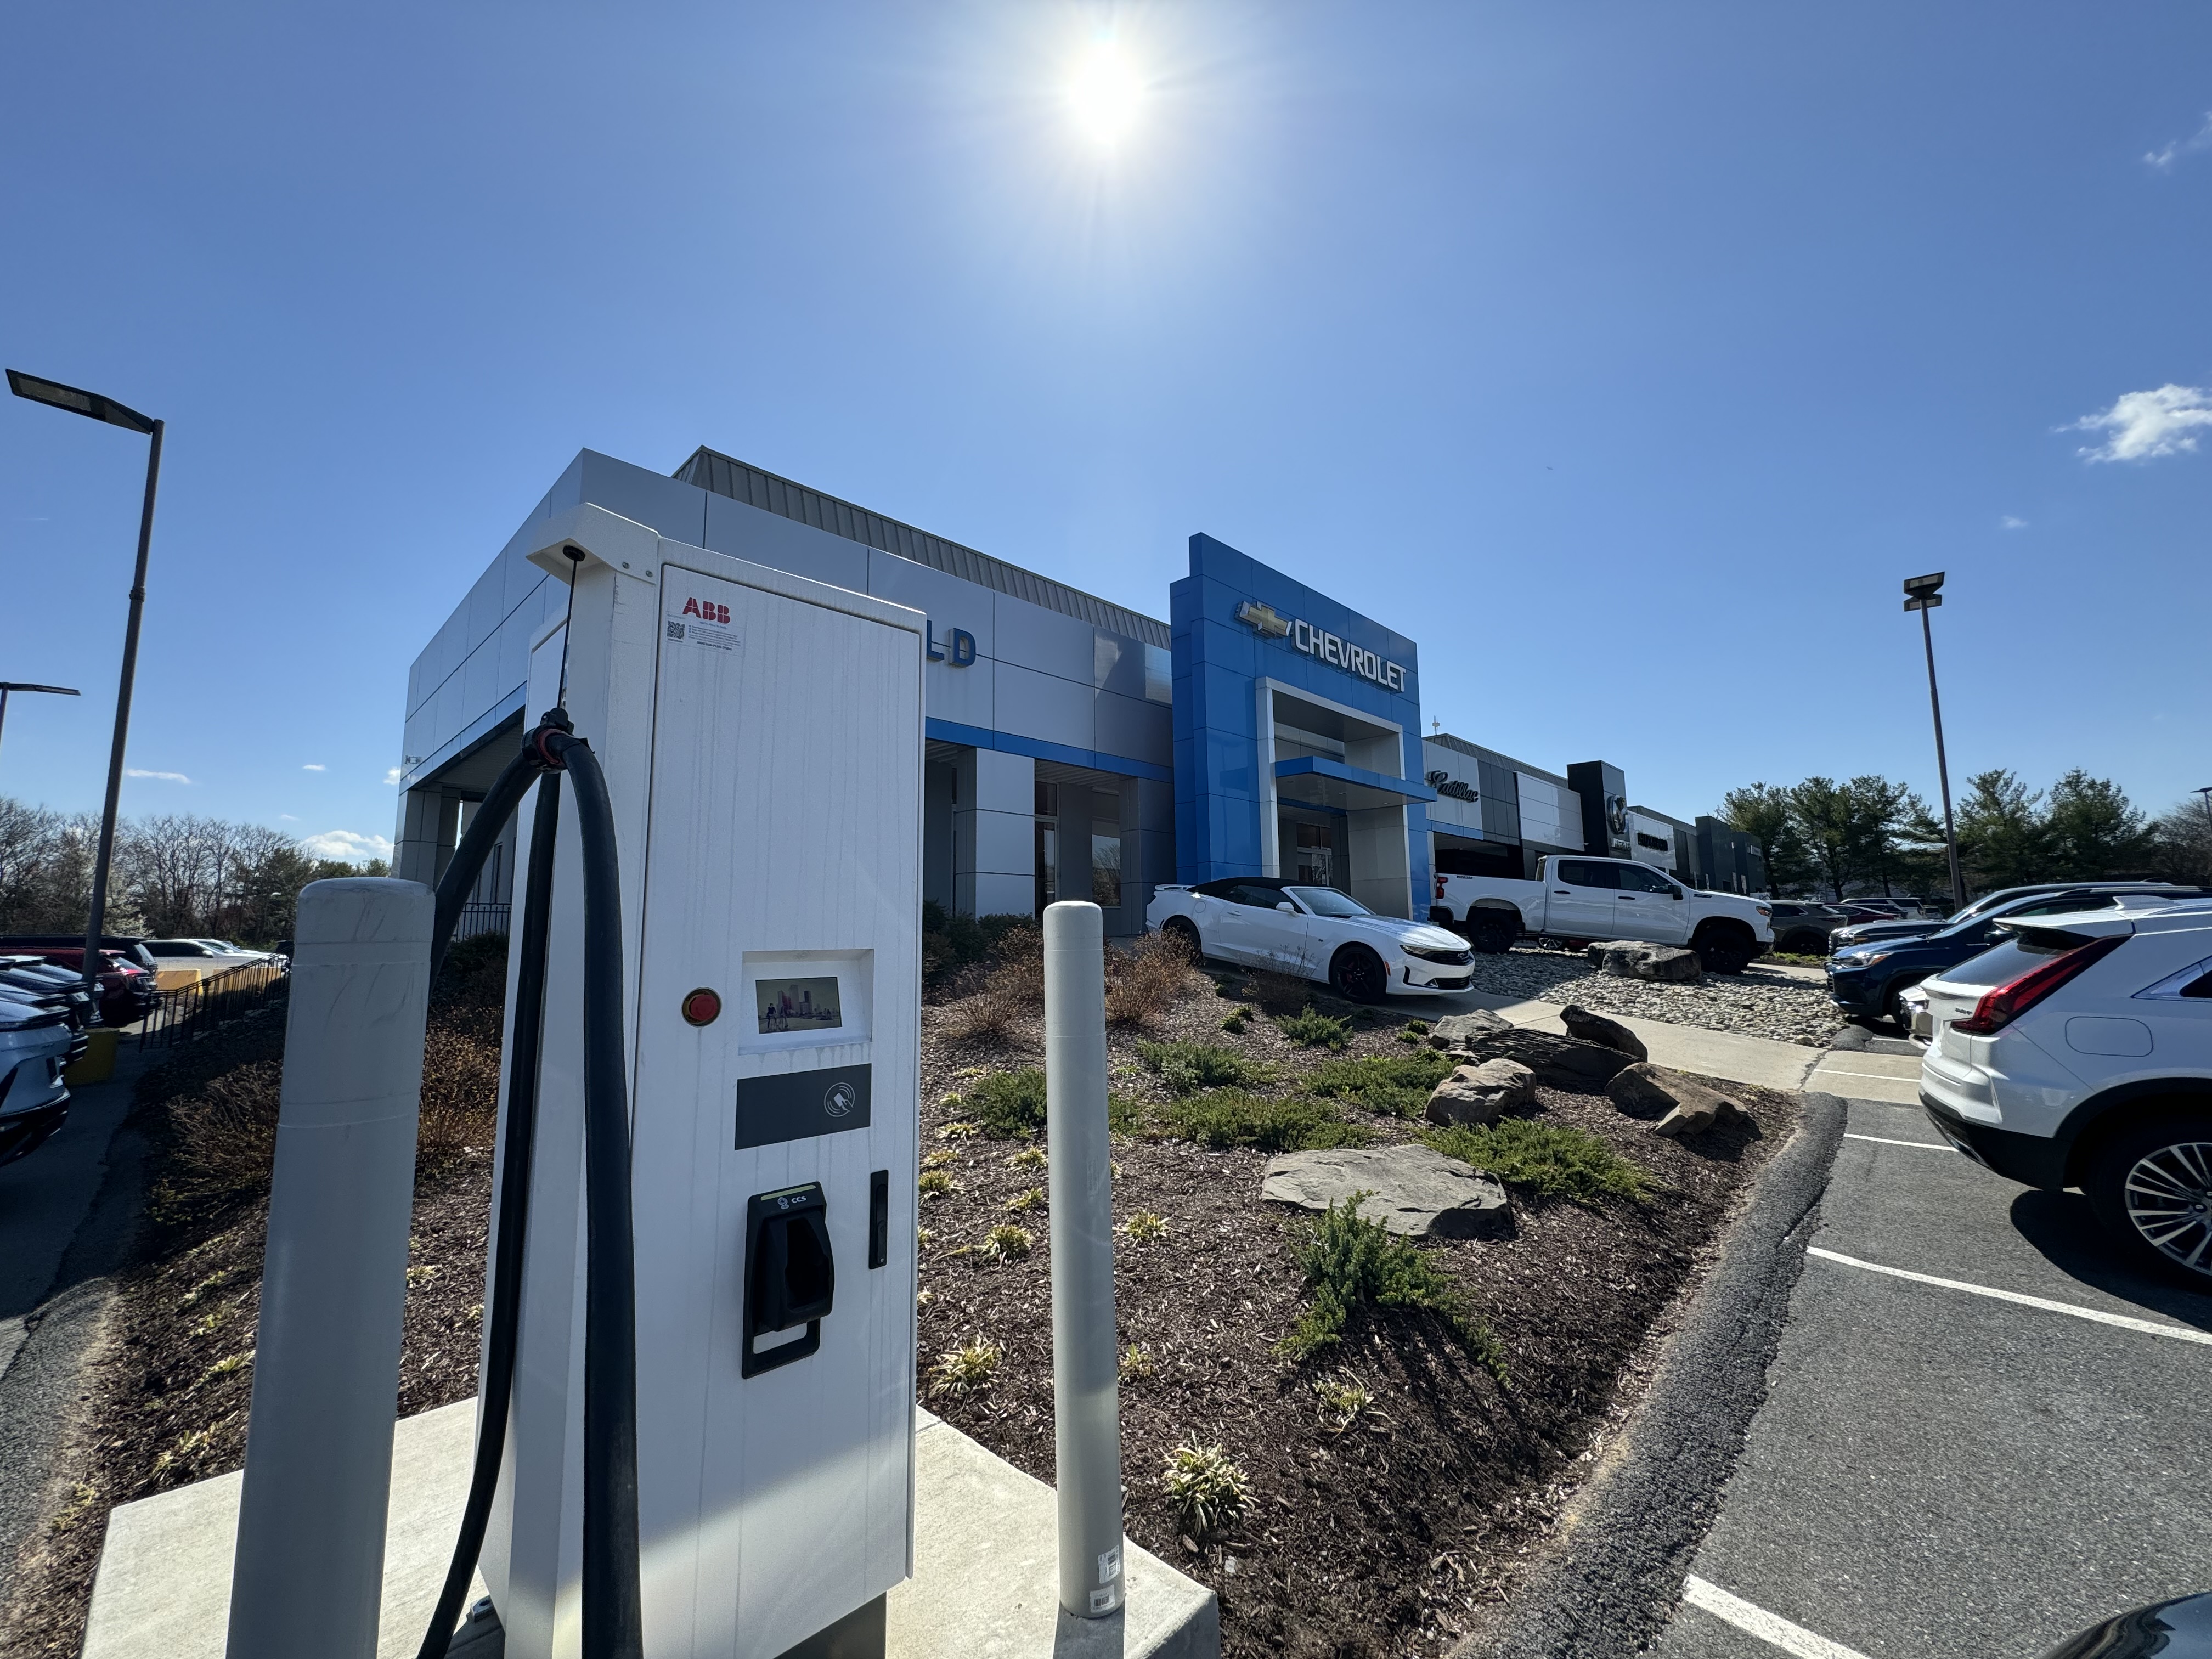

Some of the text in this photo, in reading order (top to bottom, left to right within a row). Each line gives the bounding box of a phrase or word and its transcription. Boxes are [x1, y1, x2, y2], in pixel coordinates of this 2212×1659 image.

[682, 597, 731, 624] ABB
[1292, 618, 1407, 692] CHEVROLET
[1425, 770, 1479, 803] Cadillac
[791, 1195, 807, 1204] CCS
